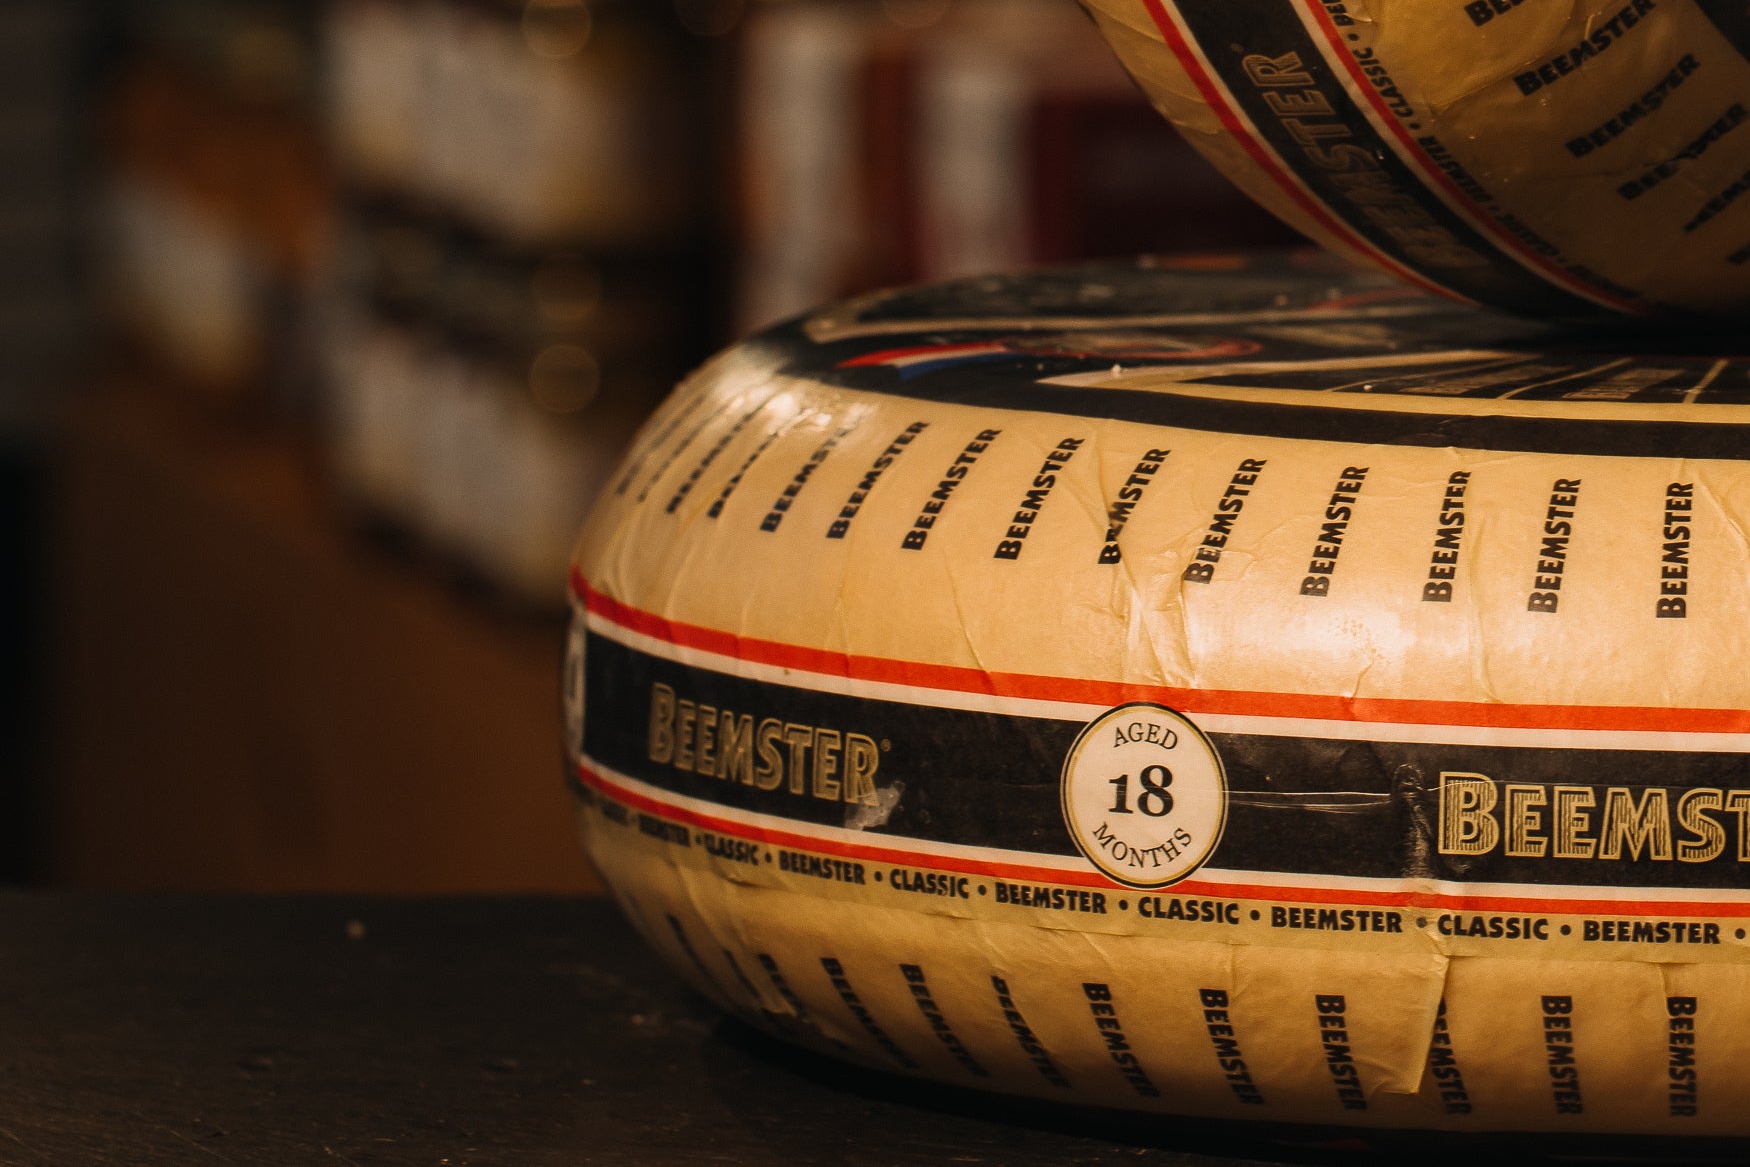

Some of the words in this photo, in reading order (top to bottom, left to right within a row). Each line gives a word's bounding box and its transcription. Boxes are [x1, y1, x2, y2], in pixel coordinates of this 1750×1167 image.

[1352, 47, 1414, 118] CLASSIC
[1565, 53, 1701, 159] BEEMSTER
[827, 421, 929, 539] BEEMSTER
[901, 428, 1003, 551] BEEMSTER
[994, 437, 1085, 560] BEEMSTER
[1184, 458, 1267, 584] BEEMSTER
[1301, 466, 1370, 597] BEEMSTER
[1421, 470, 1471, 603] BEEMSTER
[1527, 478, 1581, 614] BEEMSTER
[1656, 481, 1693, 619] BEEMSTER
[1107, 764, 1174, 817] 18
[1112, 720, 1179, 750] AGED
[779, 851, 866, 885] BEEMSTER
[890, 868, 970, 899] CLASSIC
[995, 882, 1106, 914] BEEMSTER
[1139, 896, 1239, 925] CLASSIC
[1272, 906, 1402, 933] BEEMSTER
[1437, 914, 1549, 941] CLASSIC
[1583, 921, 1720, 945] BEEMSTER
[1092, 827, 1193, 868] MONTHS
[1083, 981, 1161, 1099] BEEMSTER
[1199, 988, 1264, 1106] BEEMSTER
[1316, 994, 1367, 1112] BEEMSTER
[1430, 996, 1472, 1115] EEMSTER
[1541, 995, 1583, 1116] BEEMSTER
[1667, 995, 1698, 1118] BEEMSTER
